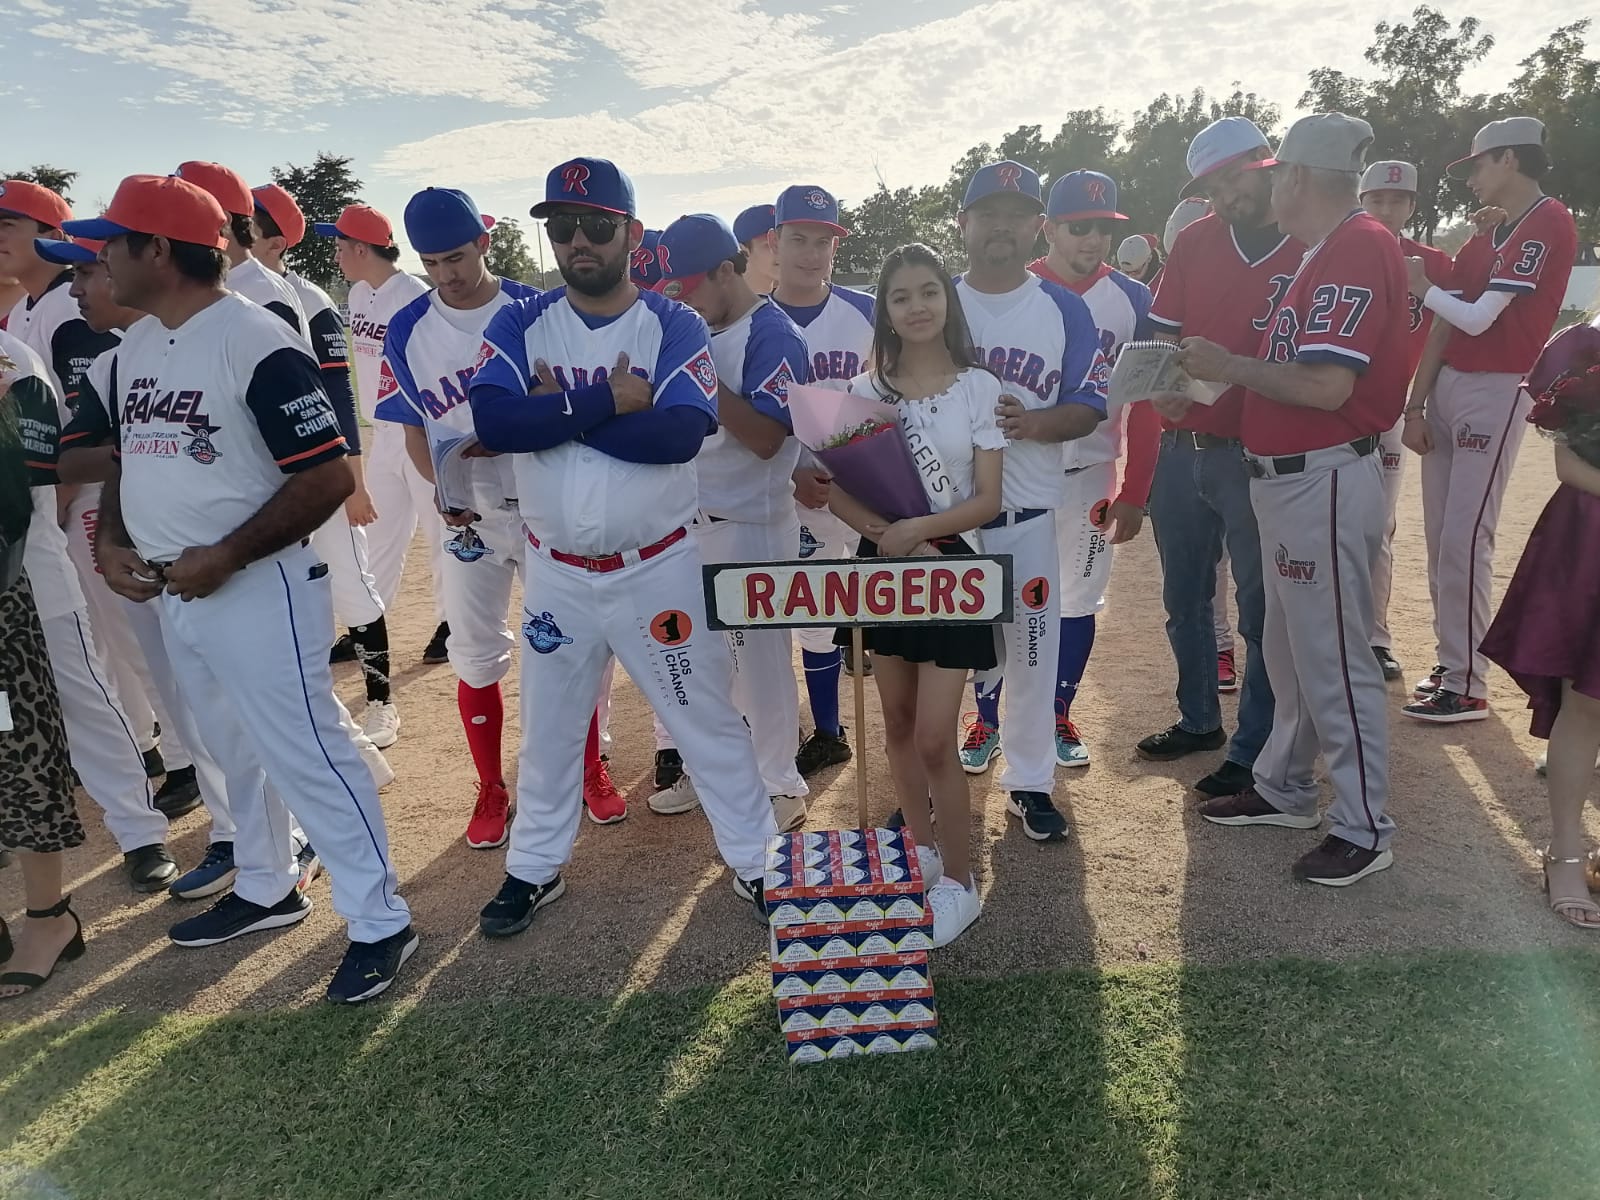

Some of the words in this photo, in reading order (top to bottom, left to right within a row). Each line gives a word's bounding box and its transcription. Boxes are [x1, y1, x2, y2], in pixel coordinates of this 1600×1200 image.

[561, 163, 590, 196] R
[1385, 165, 1402, 184] B
[1513, 240, 1546, 276] 3
[1305, 283, 1373, 338] 27
[1083, 534, 1098, 578] CHANOS
[1279, 562, 1317, 581] GMV
[745, 567, 985, 620] RANGERS
[735, 630, 745, 648] OS
[1028, 617, 1038, 667] CHANOS
[665, 653, 689, 707] CHANOS
[677, 651, 692, 676] LOS
